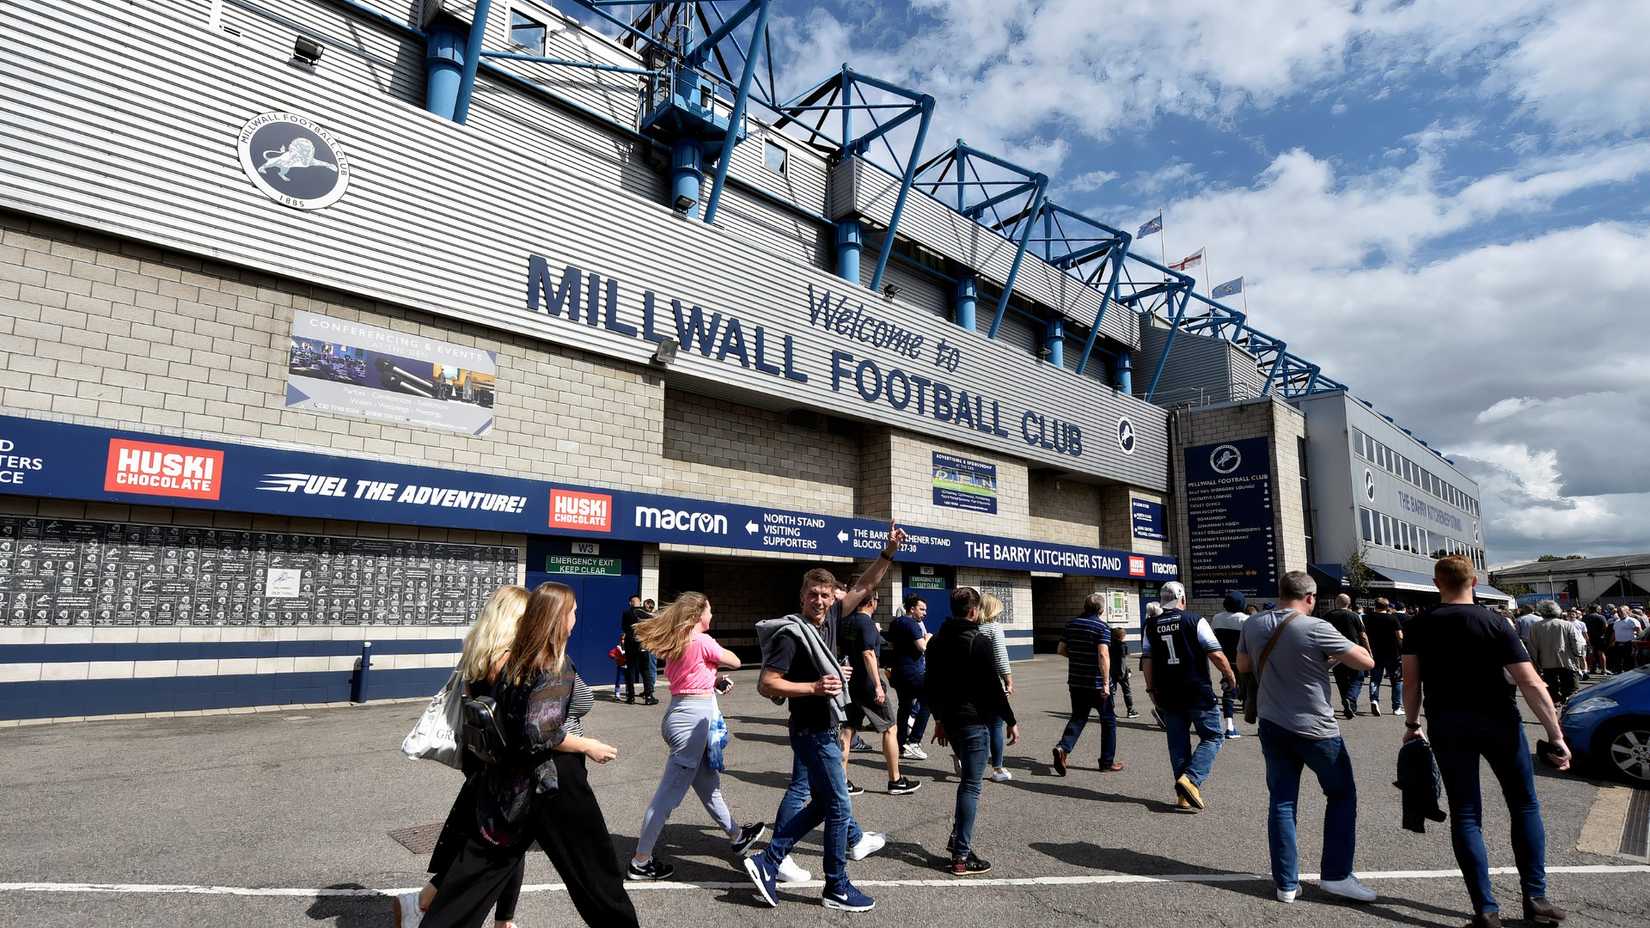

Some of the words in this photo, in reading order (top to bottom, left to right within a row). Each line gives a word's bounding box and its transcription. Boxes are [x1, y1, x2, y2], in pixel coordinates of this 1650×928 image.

[240, 113, 281, 144] MILLWALL
[283, 114, 337, 149] FOOTBALL
[335, 151, 348, 176] CLUB
[279, 195, 305, 208] 1885
[808, 283, 925, 360] Welcome
[935, 337, 961, 373] to
[527, 254, 808, 383] MILLWALL
[831, 349, 1009, 439] FOOTBALL
[1020, 410, 1083, 457] CLUB
[118, 447, 215, 480] HUSKI
[116, 472, 212, 492] CHOCOLATE
[263, 472, 349, 498] FUEL
[353, 480, 399, 502] THE
[397, 485, 528, 514] ADVENTURE!
[554, 495, 607, 517] HUSKI
[554, 514, 607, 527] CHOCOLATE
[635, 505, 728, 535] macron
[763, 513, 796, 526] NORTH
[797, 516, 825, 529] STAND
[763, 524, 801, 537] VISITING
[853, 528, 868, 539] THE
[869, 530, 890, 540] BARR
[930, 537, 951, 547] STAND
[578, 543, 594, 553] W3
[763, 536, 817, 549] SUPPORTERS
[853, 539, 882, 549] BLOCKS
[550, 556, 597, 566] EMERGENCY
[599, 558, 614, 567] EXIT
[964, 541, 991, 560] THE
[993, 543, 1031, 563] BARRY
[1034, 548, 1090, 568] KITCHENER
[1091, 555, 1121, 571] STAND
[559, 565, 580, 574] KEEP
[581, 566, 606, 575] CLEAR
[1151, 561, 1178, 575] macron
[1157, 623, 1180, 633] COACH
[1160, 634, 1180, 665] 1
